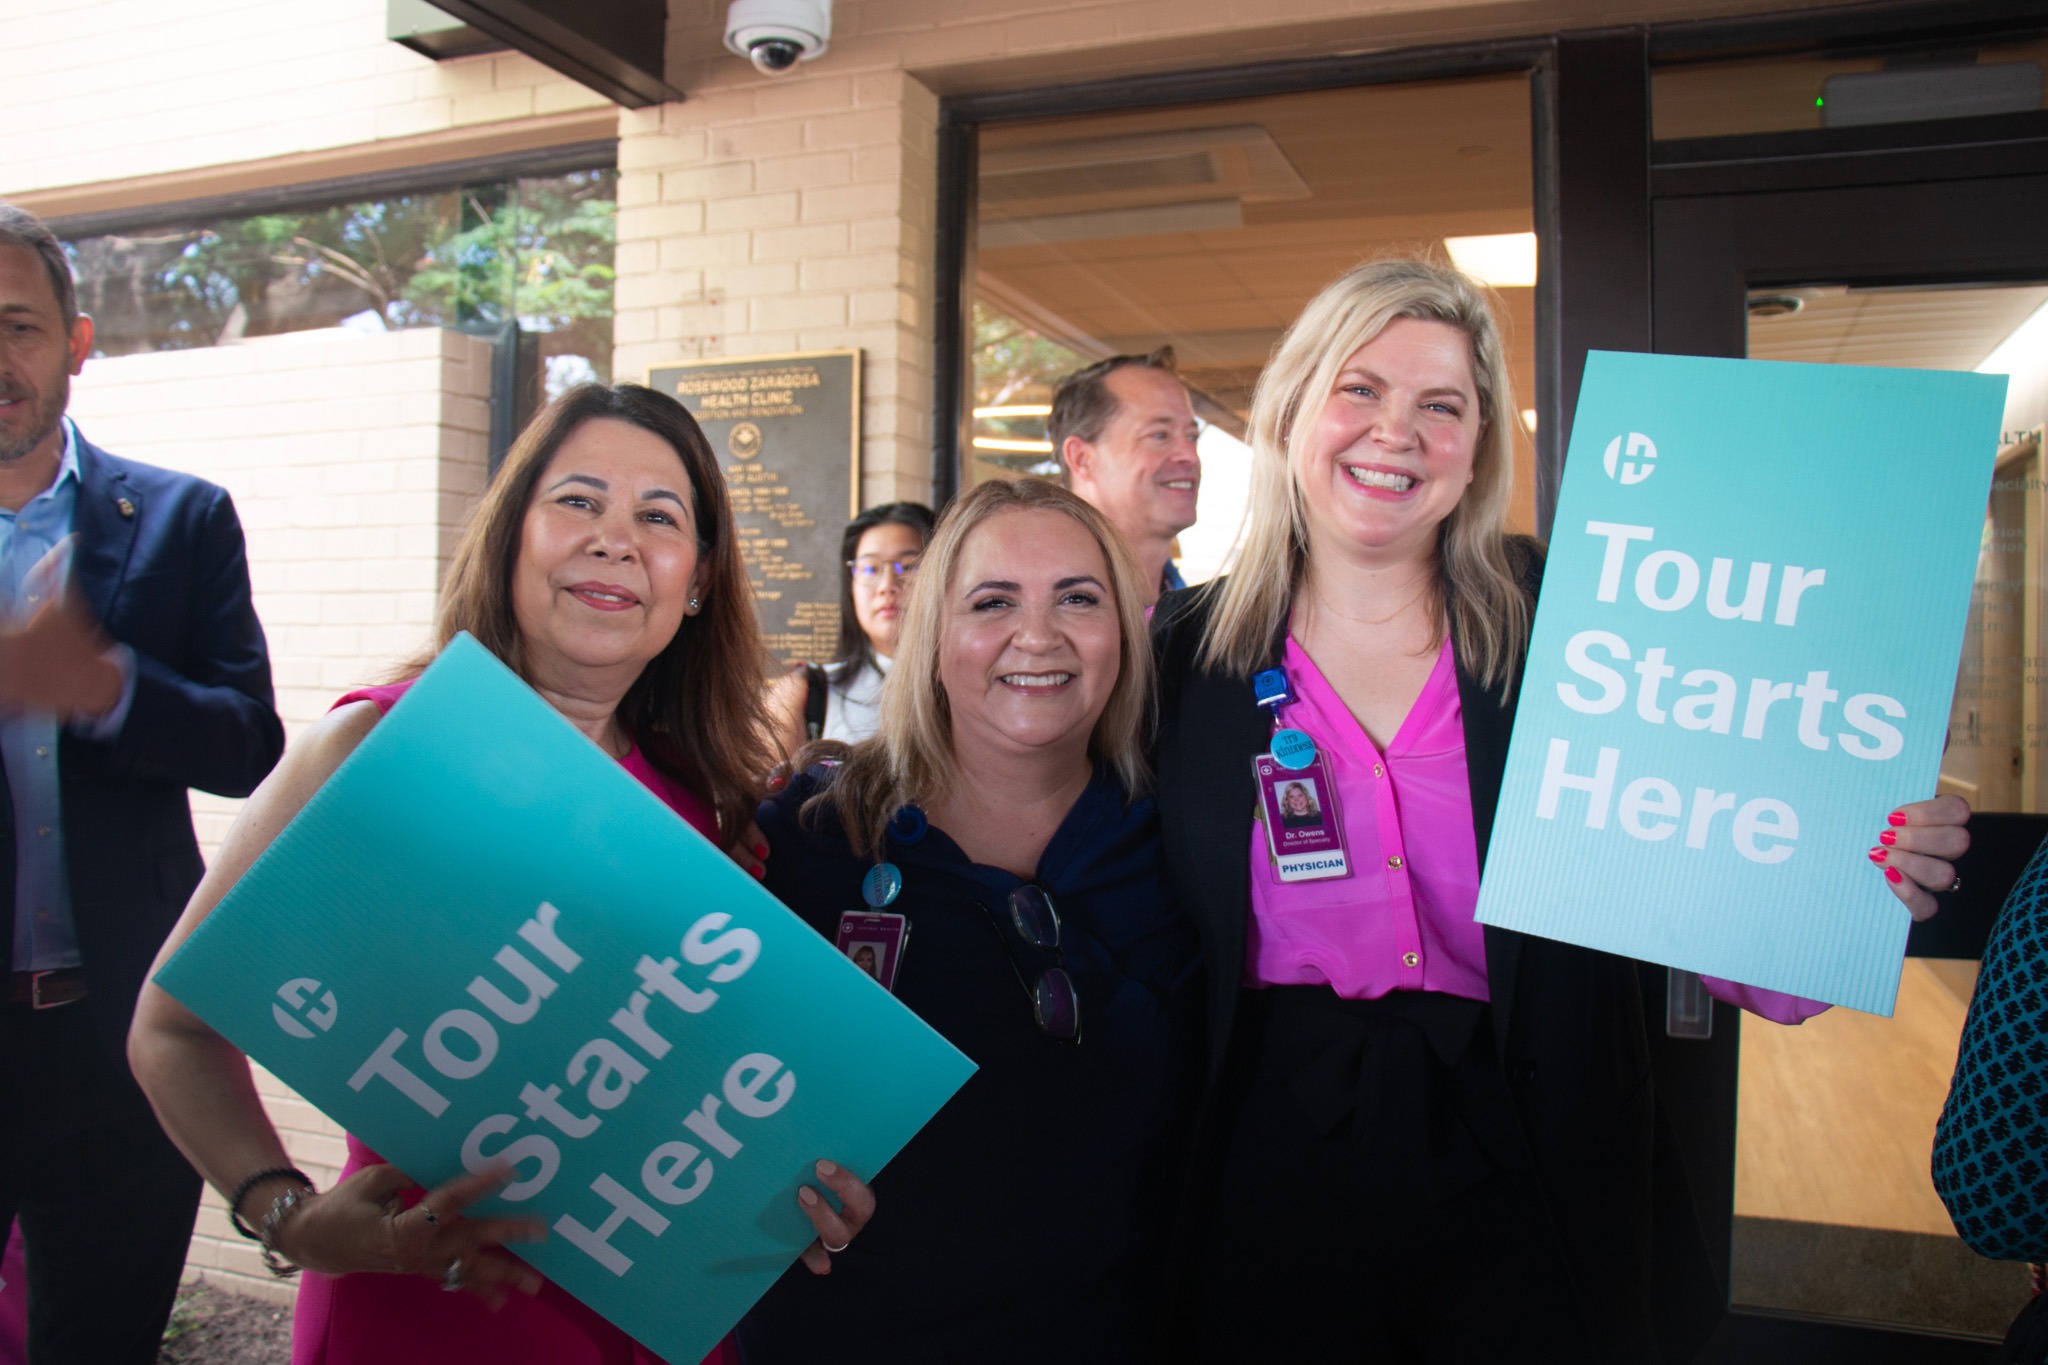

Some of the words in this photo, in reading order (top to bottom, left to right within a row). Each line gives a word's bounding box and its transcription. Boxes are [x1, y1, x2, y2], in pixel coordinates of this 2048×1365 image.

[677, 377, 749, 395] ROSEWOOD
[700, 393, 750, 408] HEALTH
[751, 390, 794, 406] CLINIC
[1585, 520, 1827, 627] Tour
[1555, 629, 1908, 761] Starts
[1285, 831, 1298, 840] Dr.
[1298, 829, 1326, 839] Owens
[1536, 738, 1801, 866] Here
[1282, 858, 1344, 873] PHYSICIAN
[348, 902, 583, 1118] Tour
[460, 912, 763, 1203] Starts
[553, 1052, 797, 1278] Here
